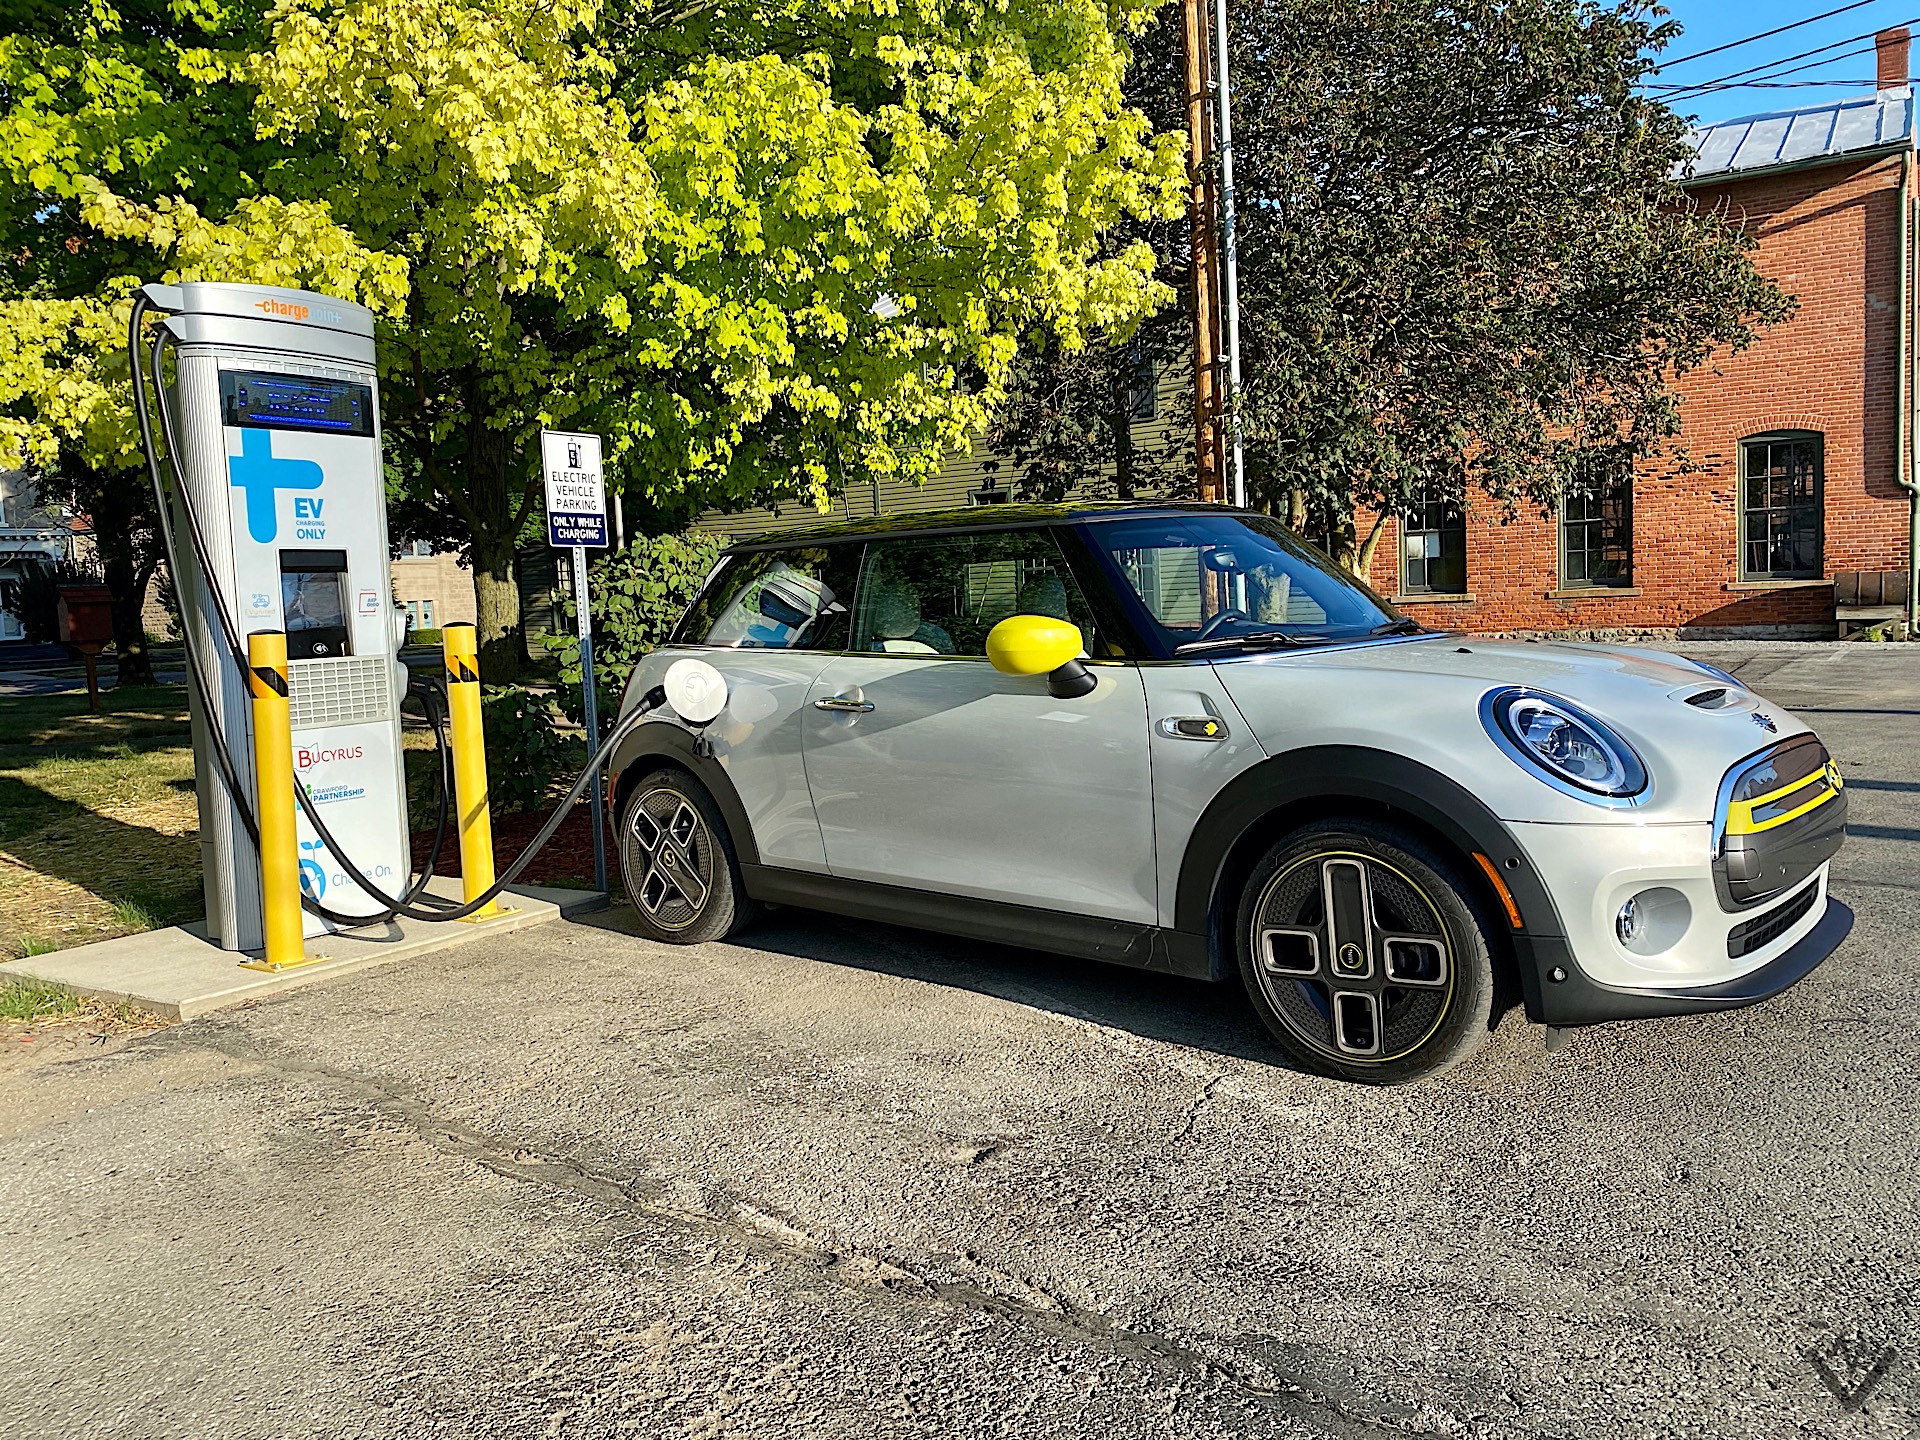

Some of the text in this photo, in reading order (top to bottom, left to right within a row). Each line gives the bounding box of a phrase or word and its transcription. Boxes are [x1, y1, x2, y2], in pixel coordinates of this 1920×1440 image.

[552, 471, 597, 484] ELECTRIC
[556, 485, 595, 497] VEHICLE
[294, 497, 323, 518] EV
[556, 499, 597, 510] PARKING
[553, 516, 602, 528] ONLY WHILE
[296, 528, 326, 540] ONLY
[558, 528, 600, 539] CHARGING
[313, 784, 348, 795] CRAWFORD
[313, 788, 365, 802] PARTNERSHIP
[332, 870, 373, 887] Chae
